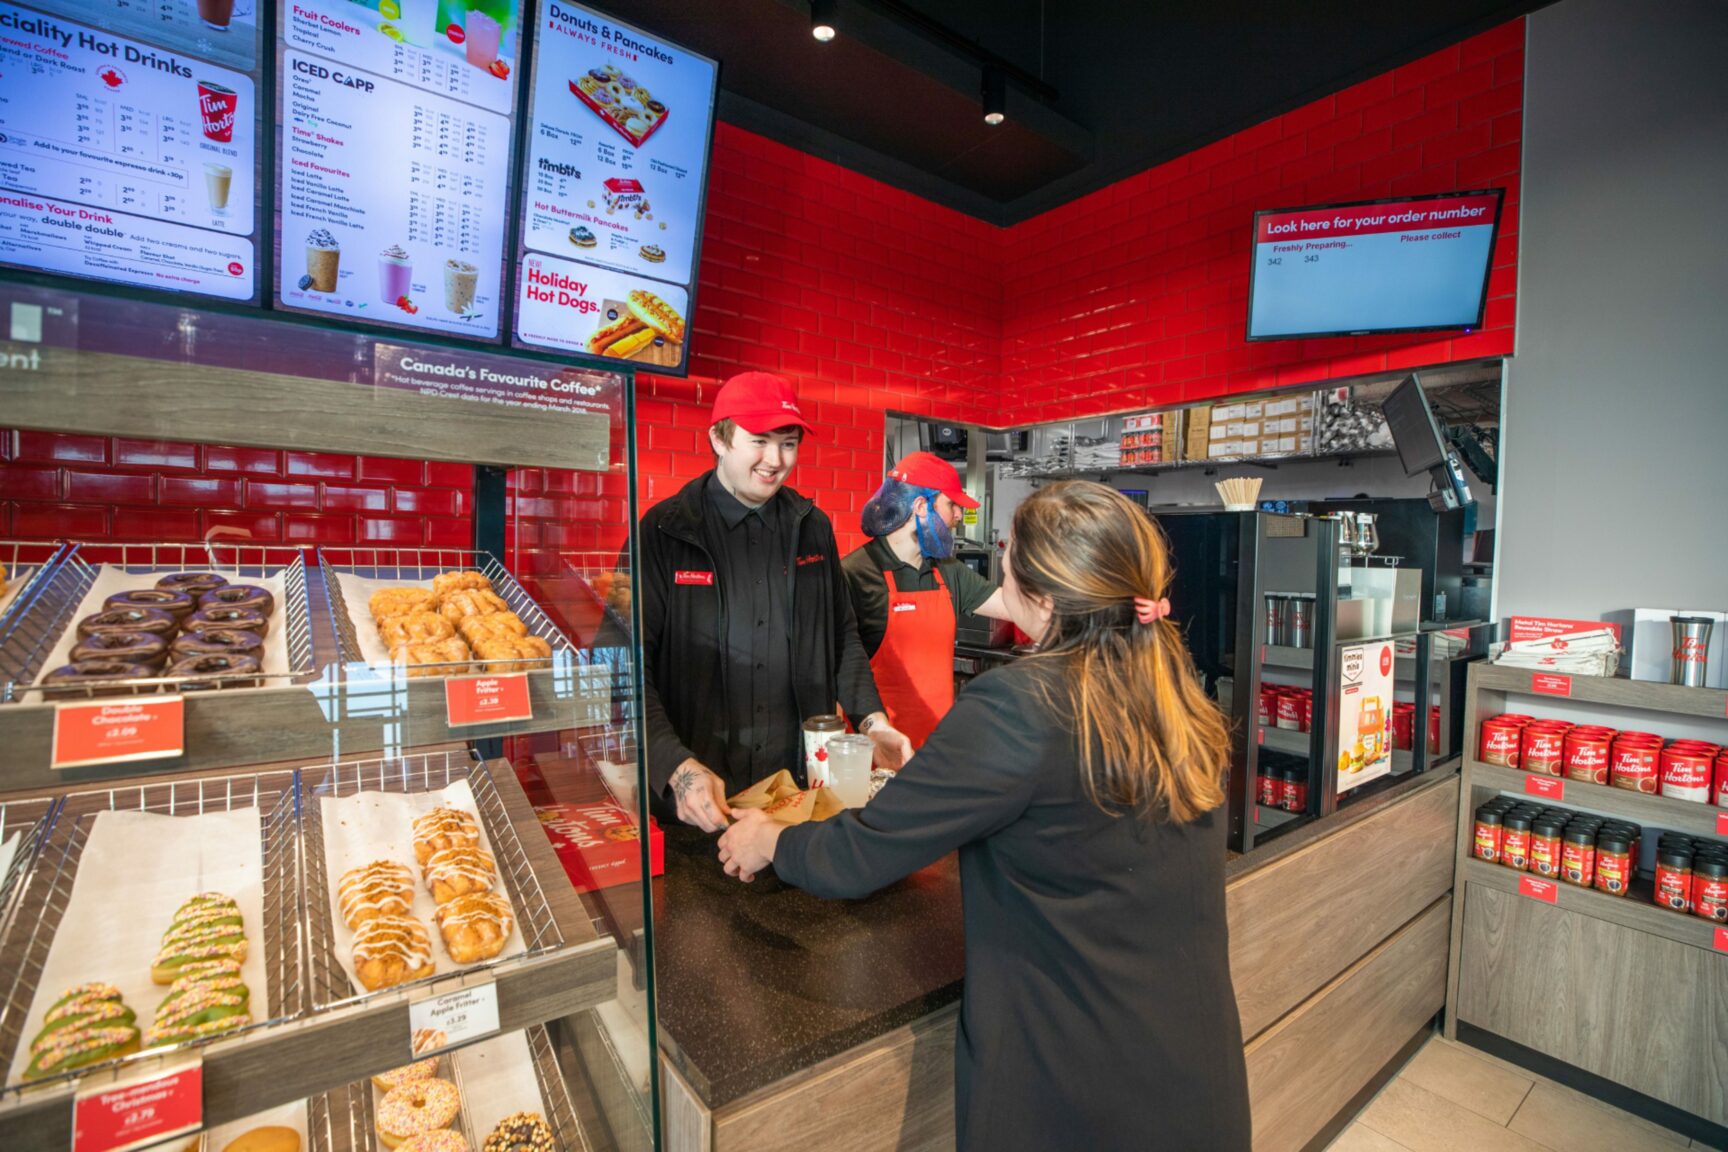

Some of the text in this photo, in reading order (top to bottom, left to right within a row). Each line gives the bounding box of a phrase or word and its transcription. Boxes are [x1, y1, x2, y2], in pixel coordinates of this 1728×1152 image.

[293, 5, 361, 36] Fruit Coolers
[293, 16, 319, 29] Sherbet
[292, 34, 335, 53] Cherry Crush
[550, 4, 674, 65] Donuts & Pancakes
[556, 24, 632, 60] ALWAYS FRESH
[34, 44, 70, 60] Coffee
[79, 31, 119, 57] Hot
[125, 45, 192, 79] Drinks
[35, 55, 58, 68] Dark
[60, 61, 86, 75] Roast
[292, 58, 329, 80] ICED
[200, 94, 228, 114] Tim
[34, 141, 50, 152] Add
[316, 133, 344, 147] Shakes
[291, 158, 351, 179] Iced Favourites
[538, 157, 582, 180] timbits
[46, 201, 77, 218] Your
[79, 209, 113, 226] Drink
[534, 200, 629, 233] Hot Buttermilk Pancakes
[1267, 205, 1487, 234] Look here for your order number
[41, 216, 82, 231] double
[130, 234, 145, 243] Add
[146, 237, 160, 246] two
[189, 246, 204, 254] and
[1400, 230, 1461, 243] Please collect
[1273, 242, 1304, 253] Freshly
[1267, 254, 1319, 266] 342 343
[528, 268, 588, 297] Holiday
[527, 285, 600, 314] Hot Dogs.
[400, 357, 477, 380] Canada's
[480, 368, 548, 390] Favourite
[411, 377, 448, 390] beverage
[450, 383, 474, 392] coffee
[476, 386, 505, 398] servings
[507, 389, 514, 397] in
[515, 391, 536, 400] coffee
[537, 394, 557, 404] shops
[559, 397, 573, 406] and
[461, 392, 479, 401] data
[480, 395, 491, 403] for
[522, 401, 547, 411] ending
[1486, 739, 1517, 750] Hortons
[1492, 731, 1508, 742] Tim
[1534, 739, 1551, 749] Tim
[1528, 747, 1560, 757] Hortons
[1570, 755, 1605, 766] Hortons
[1577, 746, 1596, 757] Tim
[1620, 752, 1640, 764] Tim
[1614, 762, 1651, 773] Hortons
[1664, 771, 1704, 782] Hortons
[1671, 761, 1692, 773] Tim
[576, 802, 629, 826] Tim
[430, 998, 480, 1016] Apple Fritter
[437, 992, 472, 1006] Caramel
